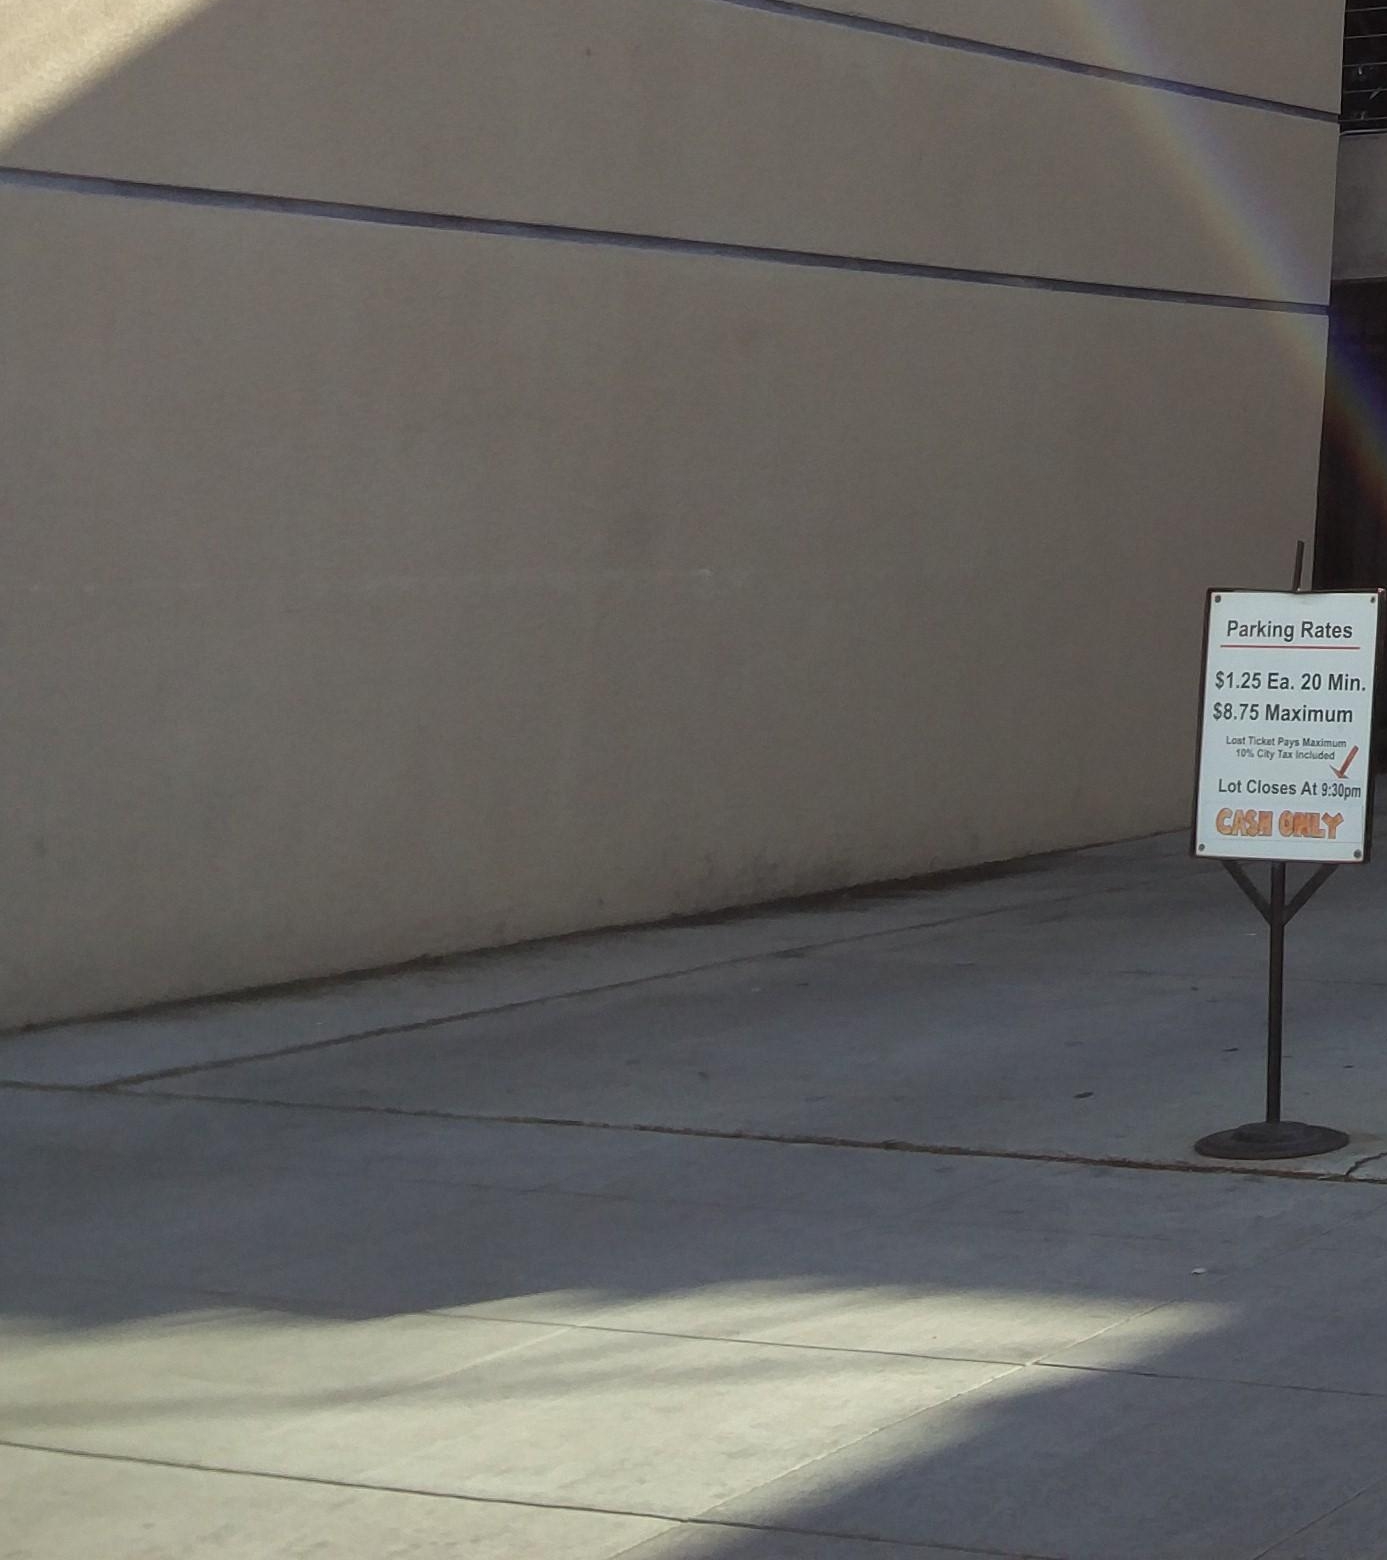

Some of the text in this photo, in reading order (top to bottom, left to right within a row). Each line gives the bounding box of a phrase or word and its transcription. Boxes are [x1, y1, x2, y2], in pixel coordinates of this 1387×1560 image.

[1227, 620, 1353, 642] Parking Rates
[1215, 671, 1366, 691] $1.25 Ea. 20 Min.
[1213, 702, 1353, 723] $8.75 Maximum
[1226, 736, 1347, 748] Lost Ticket Pays Maximum
[1236, 748, 1335, 760] 10% City Tax Included
[1218, 779, 1361, 799] Lot Closes At 9:30pm
[1216, 807, 1344, 840] CASH ONLY
